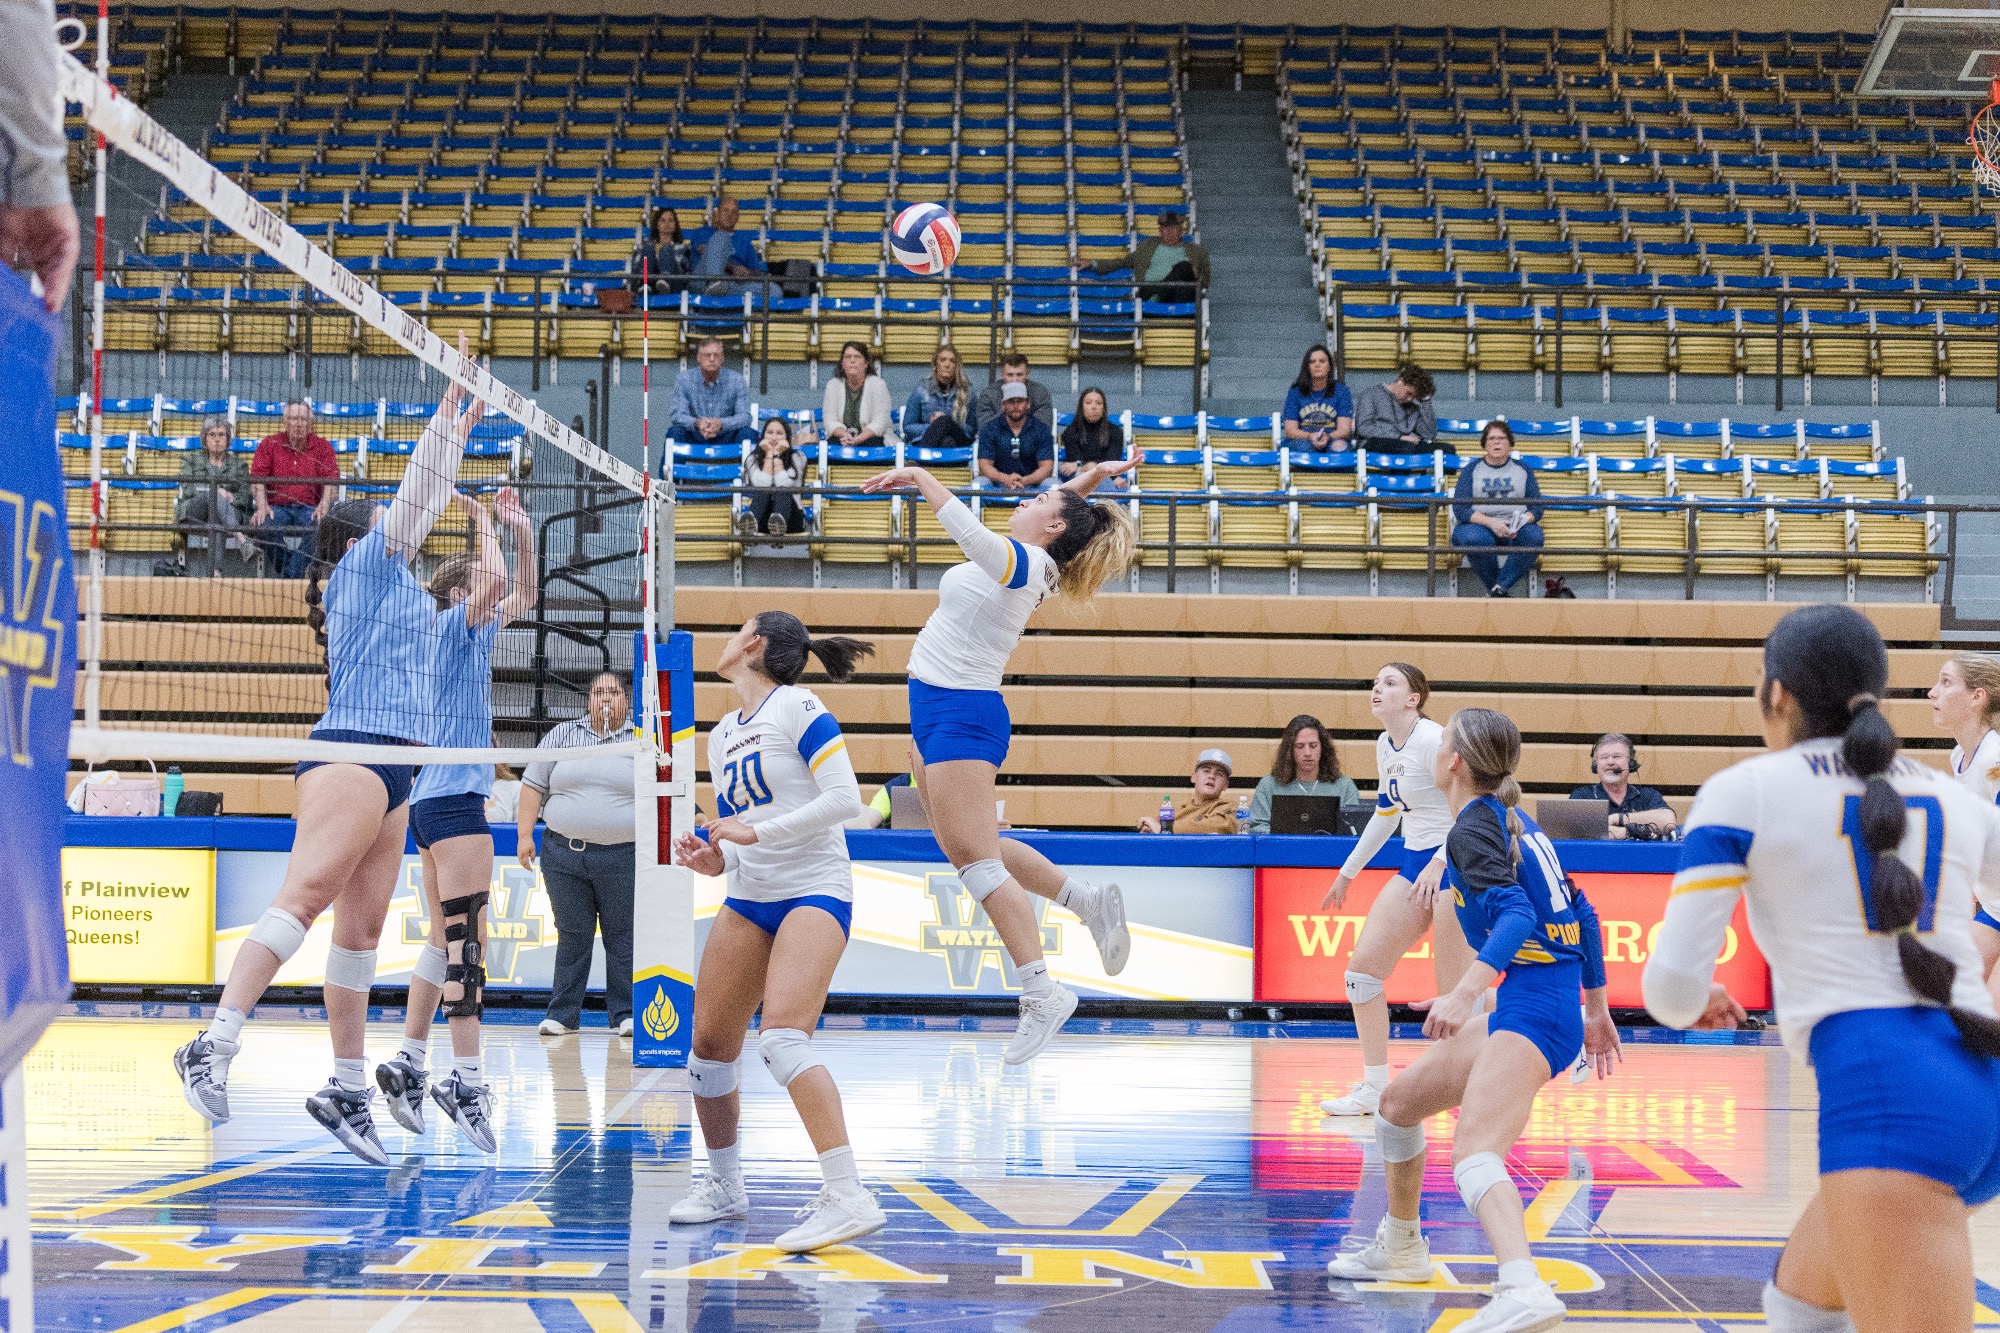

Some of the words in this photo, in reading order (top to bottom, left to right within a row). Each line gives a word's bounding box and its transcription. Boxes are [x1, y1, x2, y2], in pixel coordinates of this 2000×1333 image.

[802, 699, 816, 712] 20
[723, 750, 774, 816] 20
[81, 881, 190, 898] Plainview
[72, 905, 153, 922] Pioneers
[65, 928, 140, 945] Queens!
